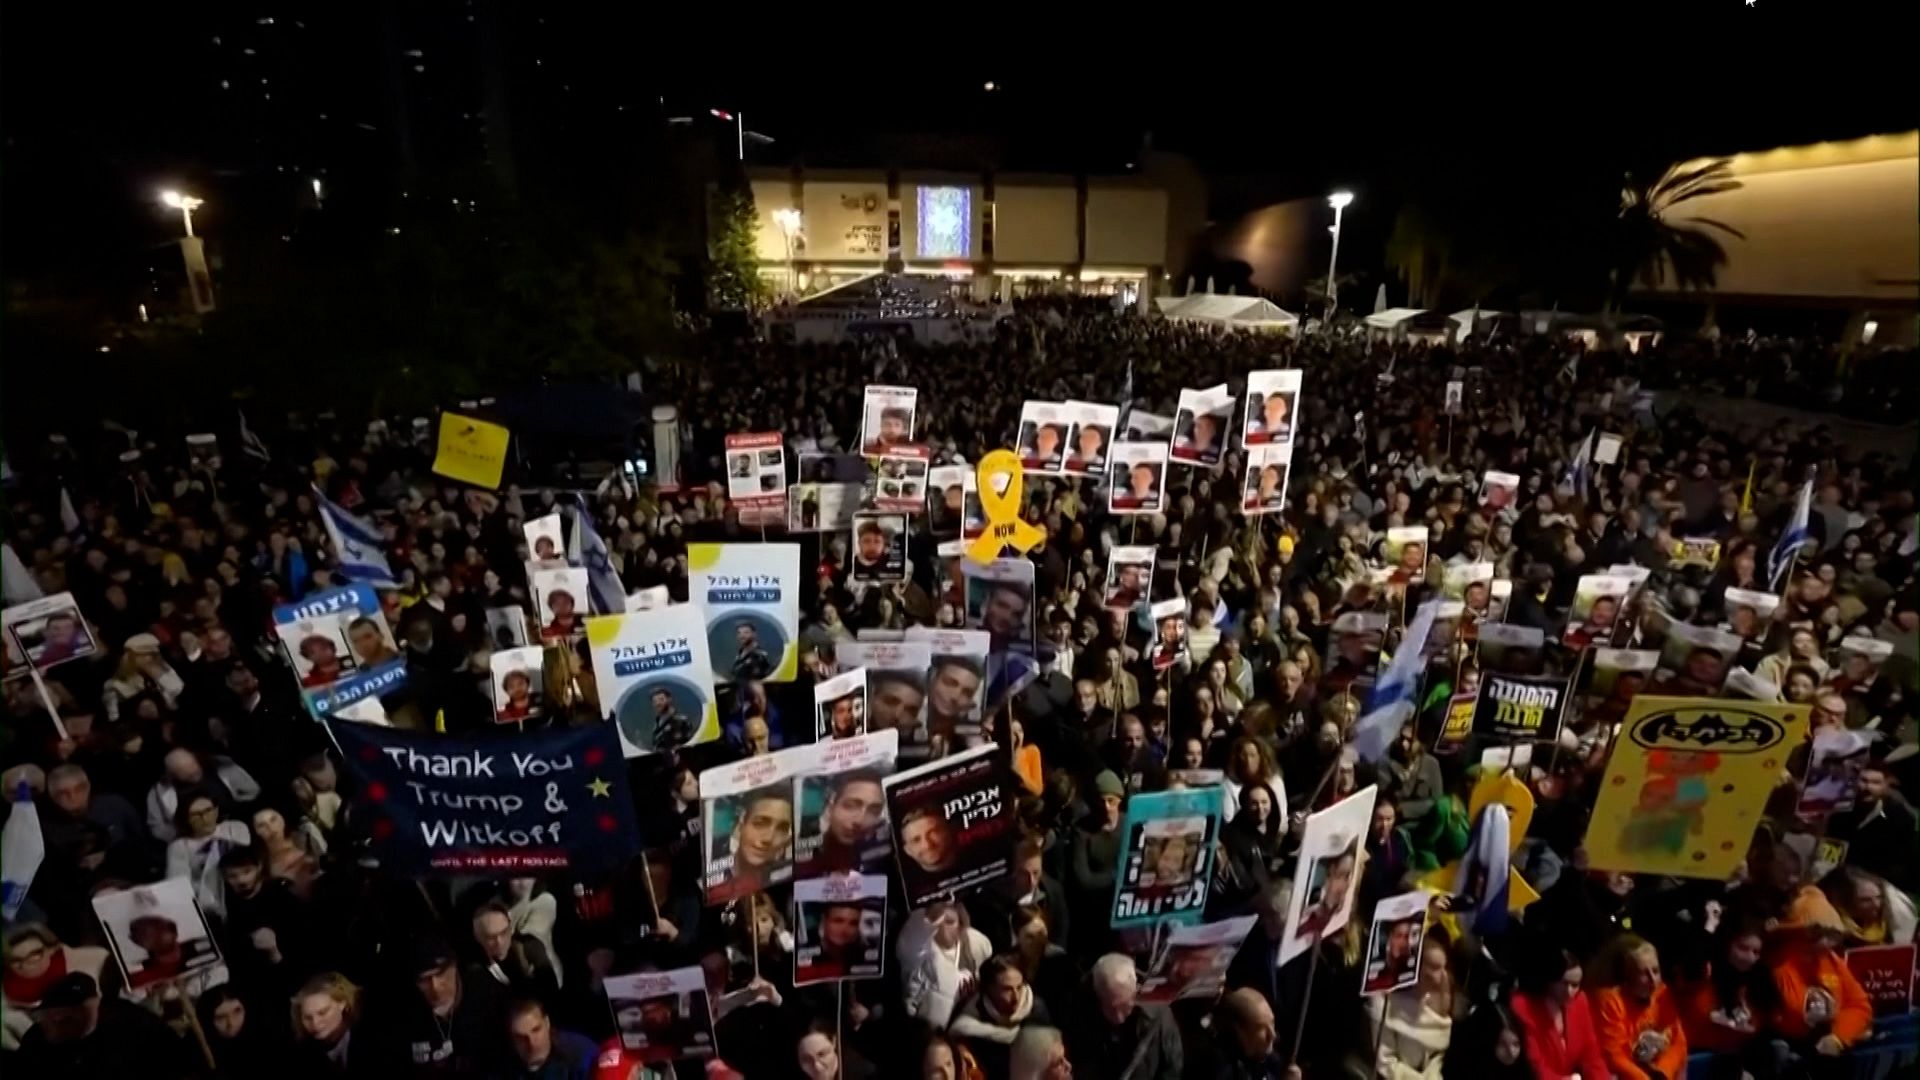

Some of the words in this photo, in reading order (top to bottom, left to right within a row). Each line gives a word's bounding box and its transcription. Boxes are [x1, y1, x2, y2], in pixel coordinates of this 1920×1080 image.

[707, 574, 741, 586] אהל
[747, 573, 781, 590] אלון
[610, 645, 646, 660] אהל
[652, 637, 688, 655] אלון
[383, 747, 495, 778] Thank
[512, 751, 573, 778] You
[406, 781, 523, 816] Trump
[544, 781, 568, 813] &
[943, 785, 999, 820] אבינתן
[962, 801, 1002, 830] עדיין
[466, 856, 487, 867] THE
[491, 856, 518, 867] LAST
